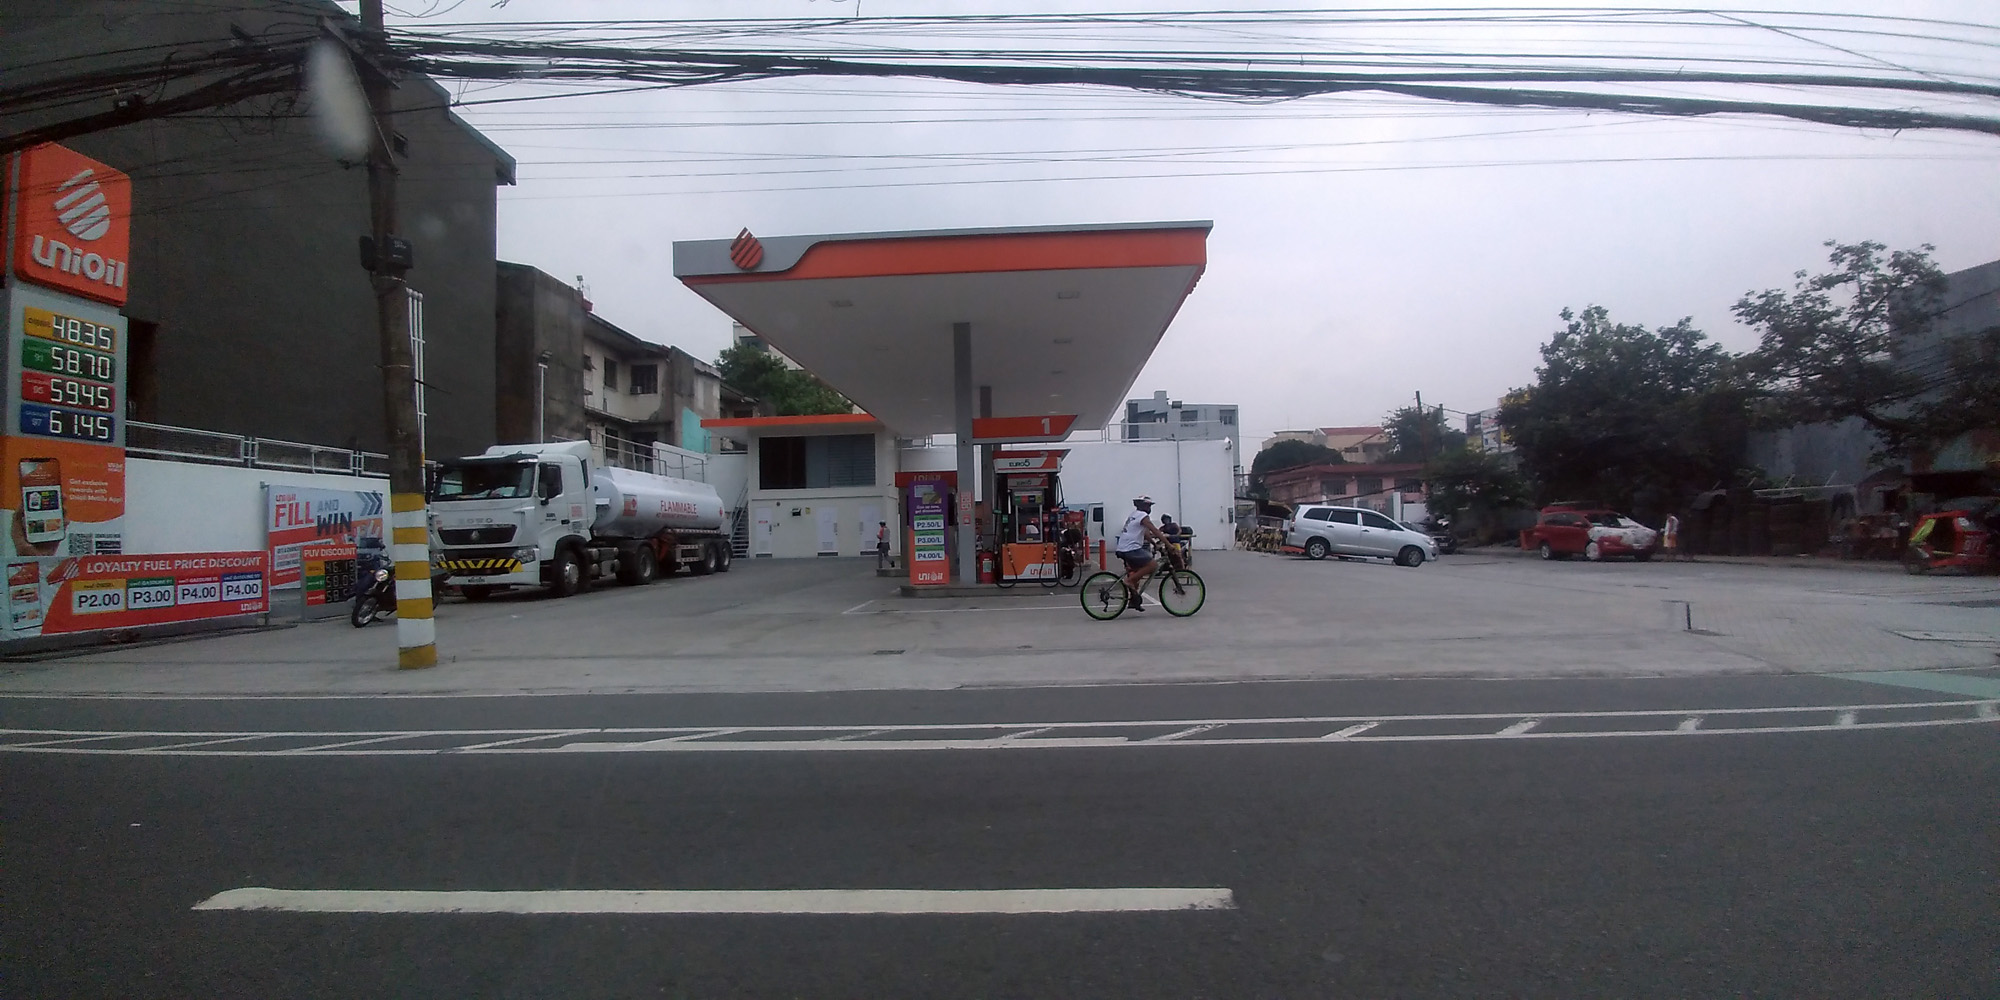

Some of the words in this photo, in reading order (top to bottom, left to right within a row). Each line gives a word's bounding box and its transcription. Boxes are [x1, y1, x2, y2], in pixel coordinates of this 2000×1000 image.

[53, 315, 111, 349] 48.35
[51, 346, 110, 379] 58.70
[50, 378, 109, 409] 59.45
[1041, 418, 1050, 434] 1
[275, 501, 314, 528] FILL
[317, 499, 339, 512] AND
[660, 500, 697, 515] FLAMMABLE
[317, 511, 352, 537] WIN
[321, 547, 357, 556] DISCOUNT
[87, 561, 141, 573] LOYALTY
[144, 560, 172, 571] FUEL
[174, 558, 207, 569] PRICE
[209, 557, 262, 568] DISCOUNT
[133, 590, 170, 604] P3.00
[182, 586, 217, 600] P4.00
[226, 583, 259, 596] P4.00
[78, 593, 120, 608] P2.00
